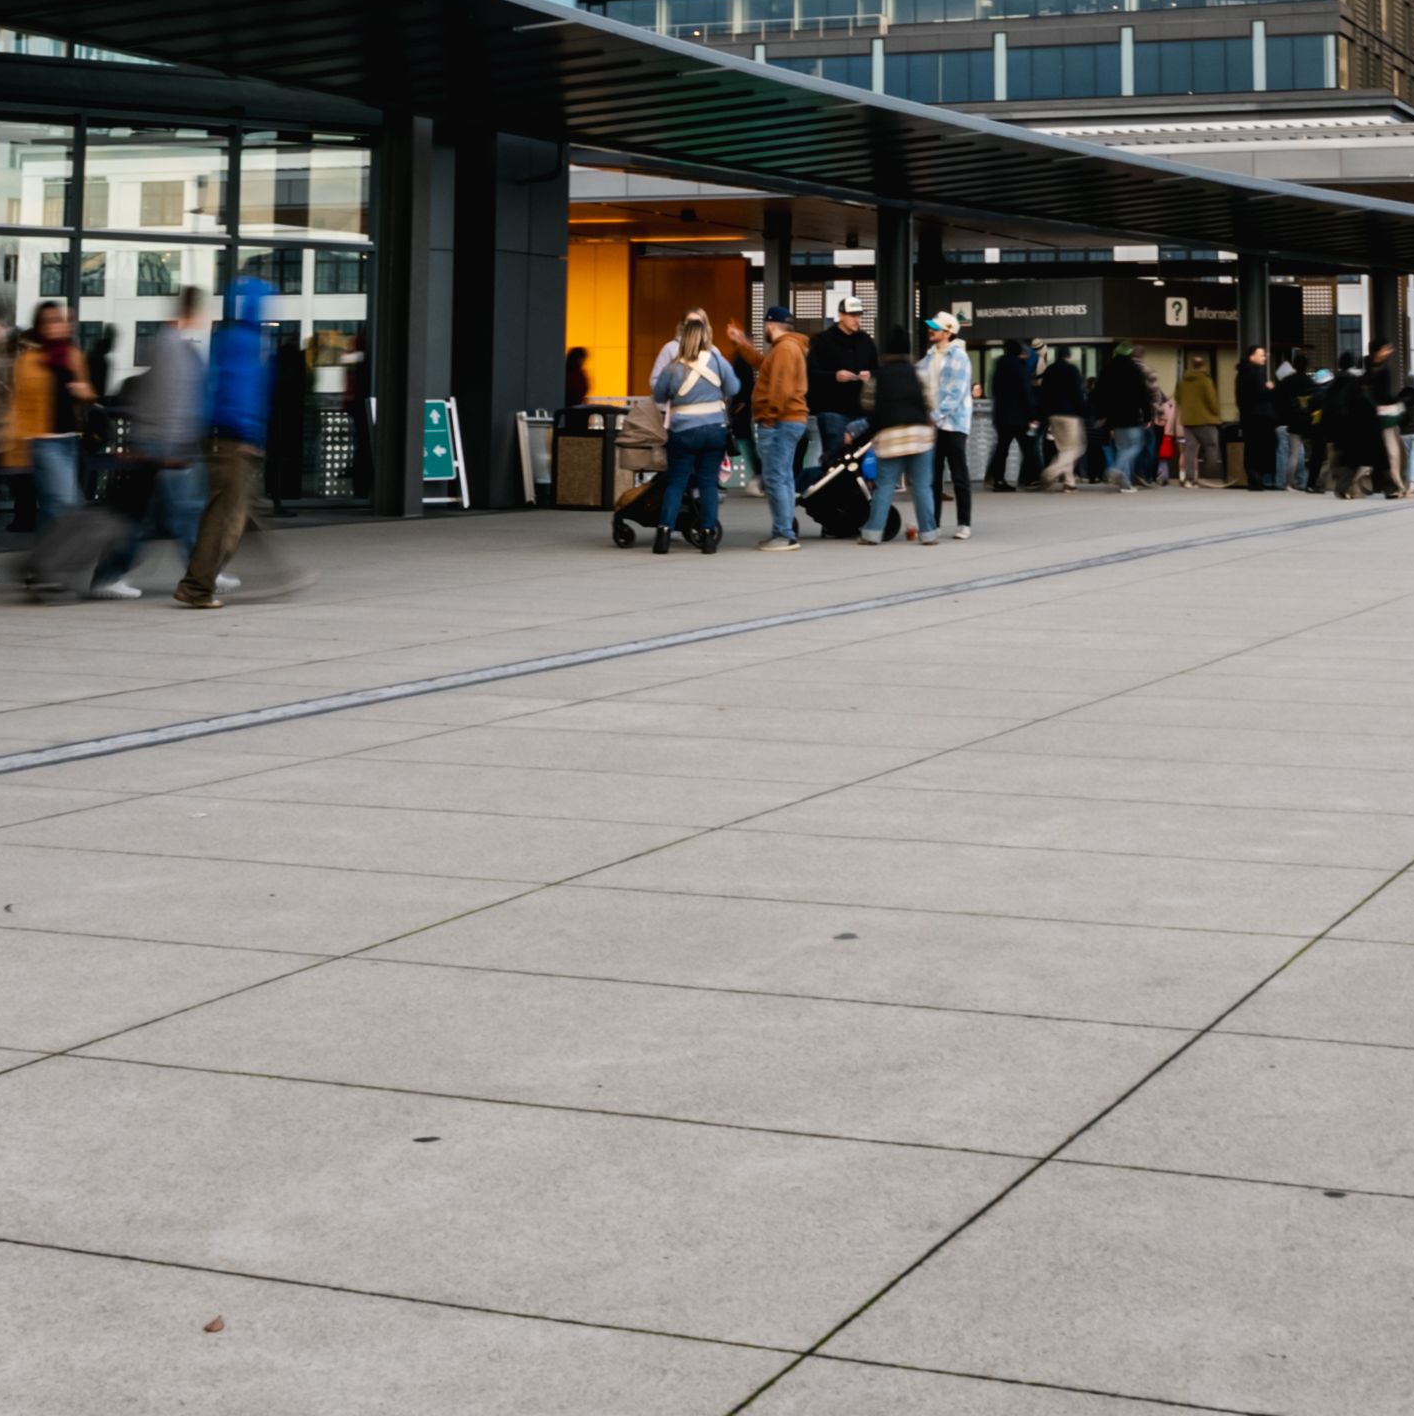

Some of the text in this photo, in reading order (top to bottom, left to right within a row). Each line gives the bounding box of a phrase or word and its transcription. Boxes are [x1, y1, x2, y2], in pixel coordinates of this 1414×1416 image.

[976, 305, 1087, 318] WASHINGTON STATE FERRIES
